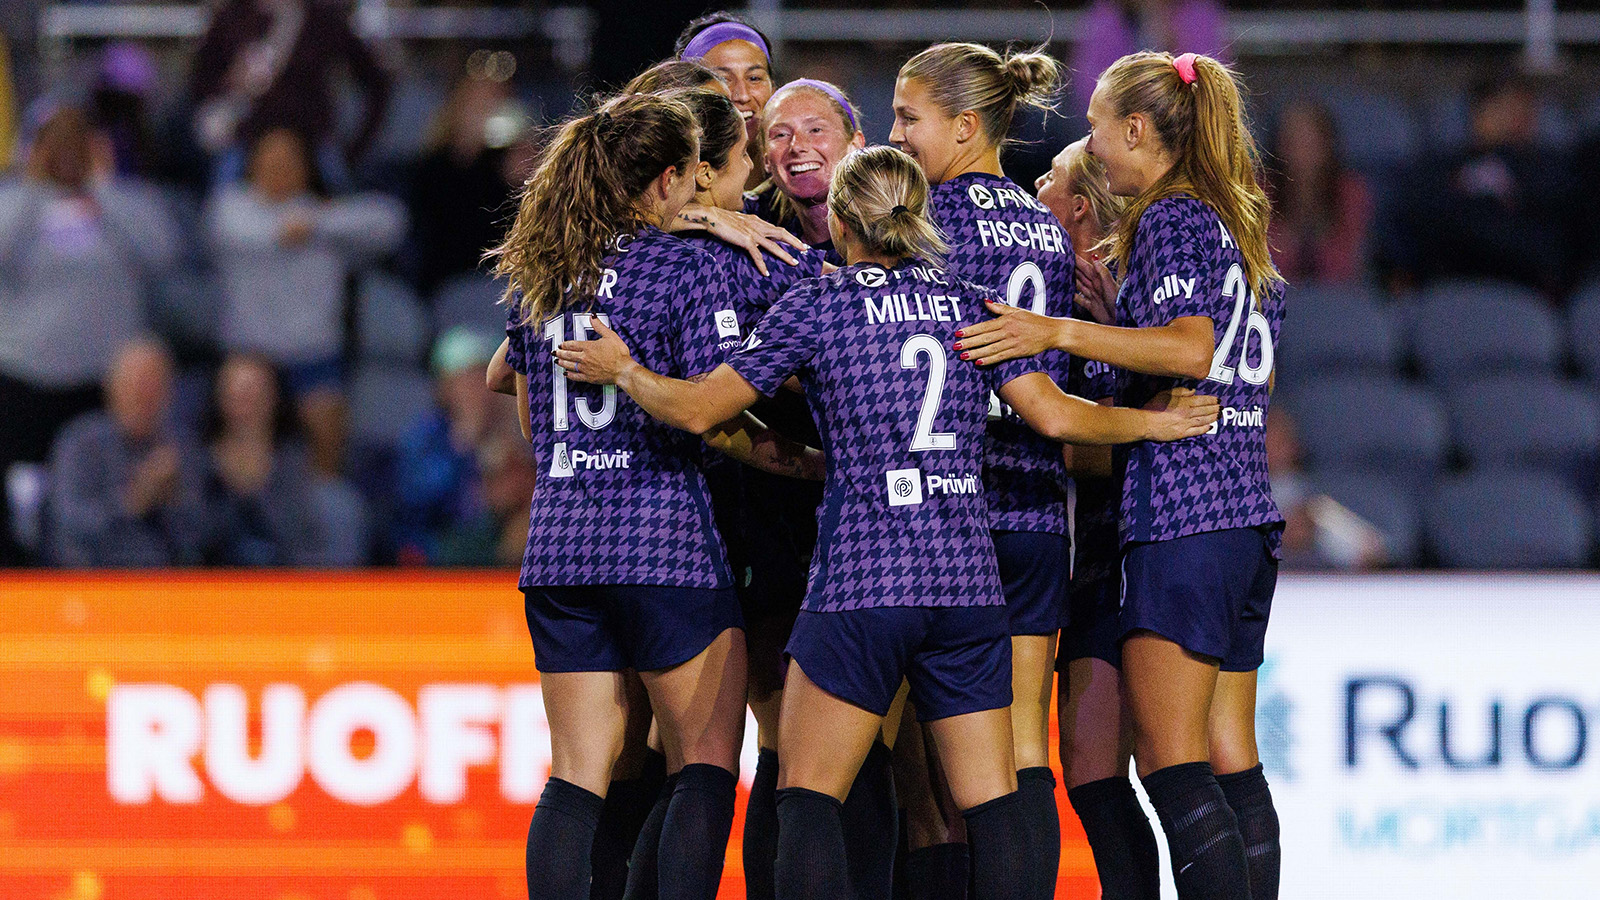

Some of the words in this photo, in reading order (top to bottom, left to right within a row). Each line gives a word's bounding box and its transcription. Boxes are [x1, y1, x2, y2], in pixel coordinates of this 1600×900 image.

[977, 220, 1065, 254] FISCHER
[1154, 274, 1196, 304] ally
[864, 293, 962, 324] MILLIET
[1206, 263, 1274, 385] 26
[544, 313, 618, 431] 15
[901, 334, 956, 451] 2
[572, 450, 633, 470] Prüvit
[927, 473, 977, 495] Prüvit
